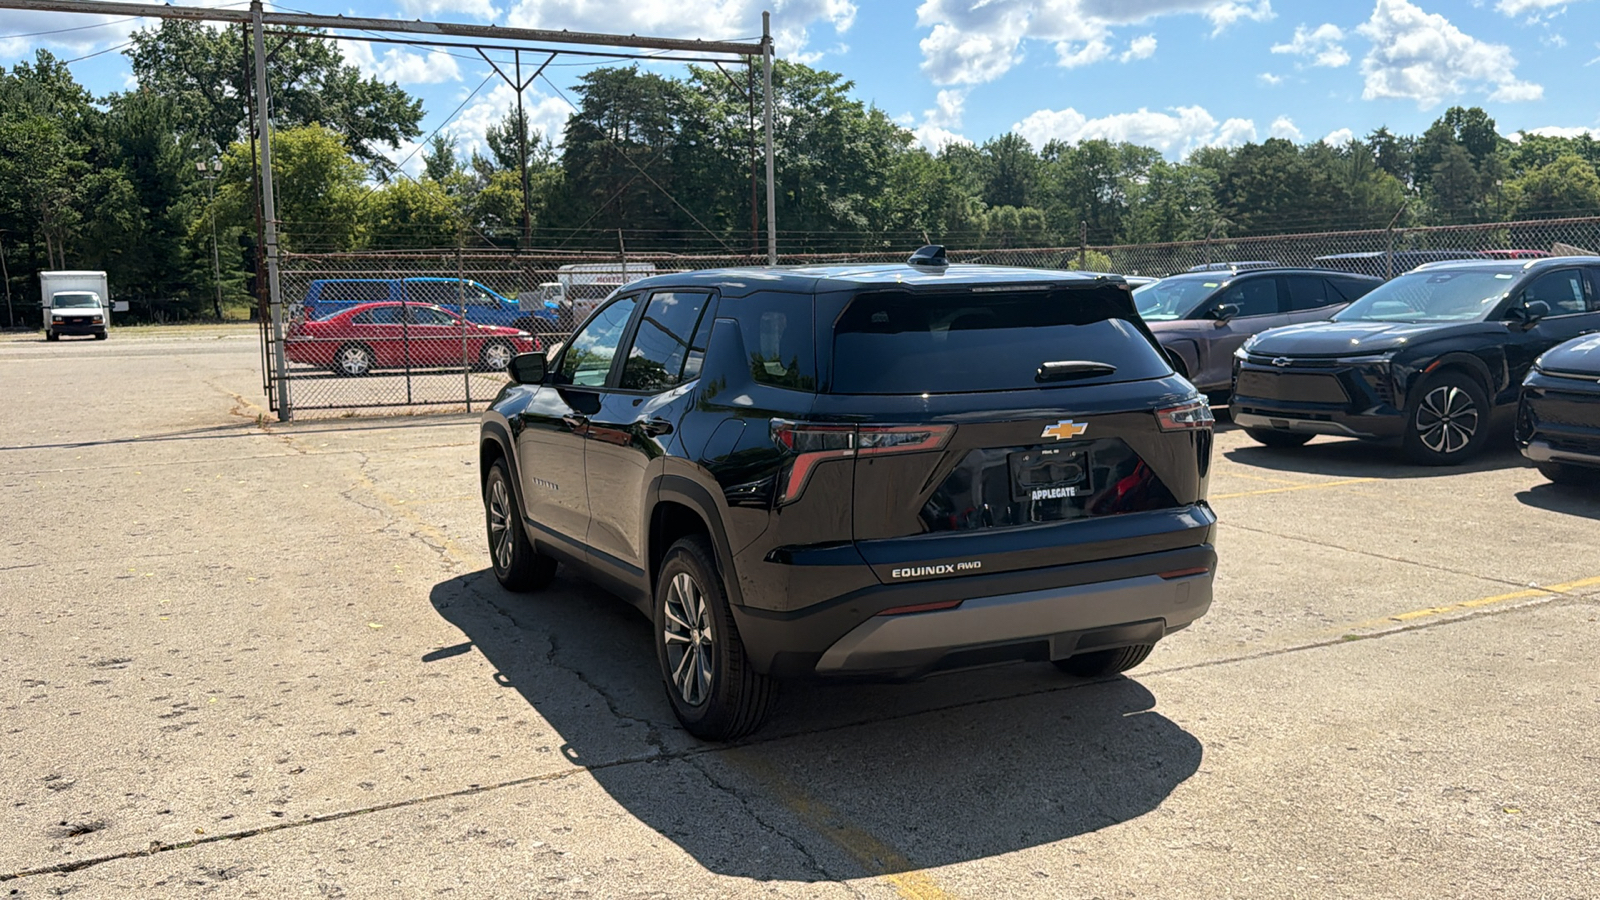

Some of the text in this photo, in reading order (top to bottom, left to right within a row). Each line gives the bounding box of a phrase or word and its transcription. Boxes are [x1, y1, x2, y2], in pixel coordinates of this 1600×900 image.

[1032, 487, 1076, 500] APPLEGATE
[892, 561, 982, 578] EQUINOX AWD
